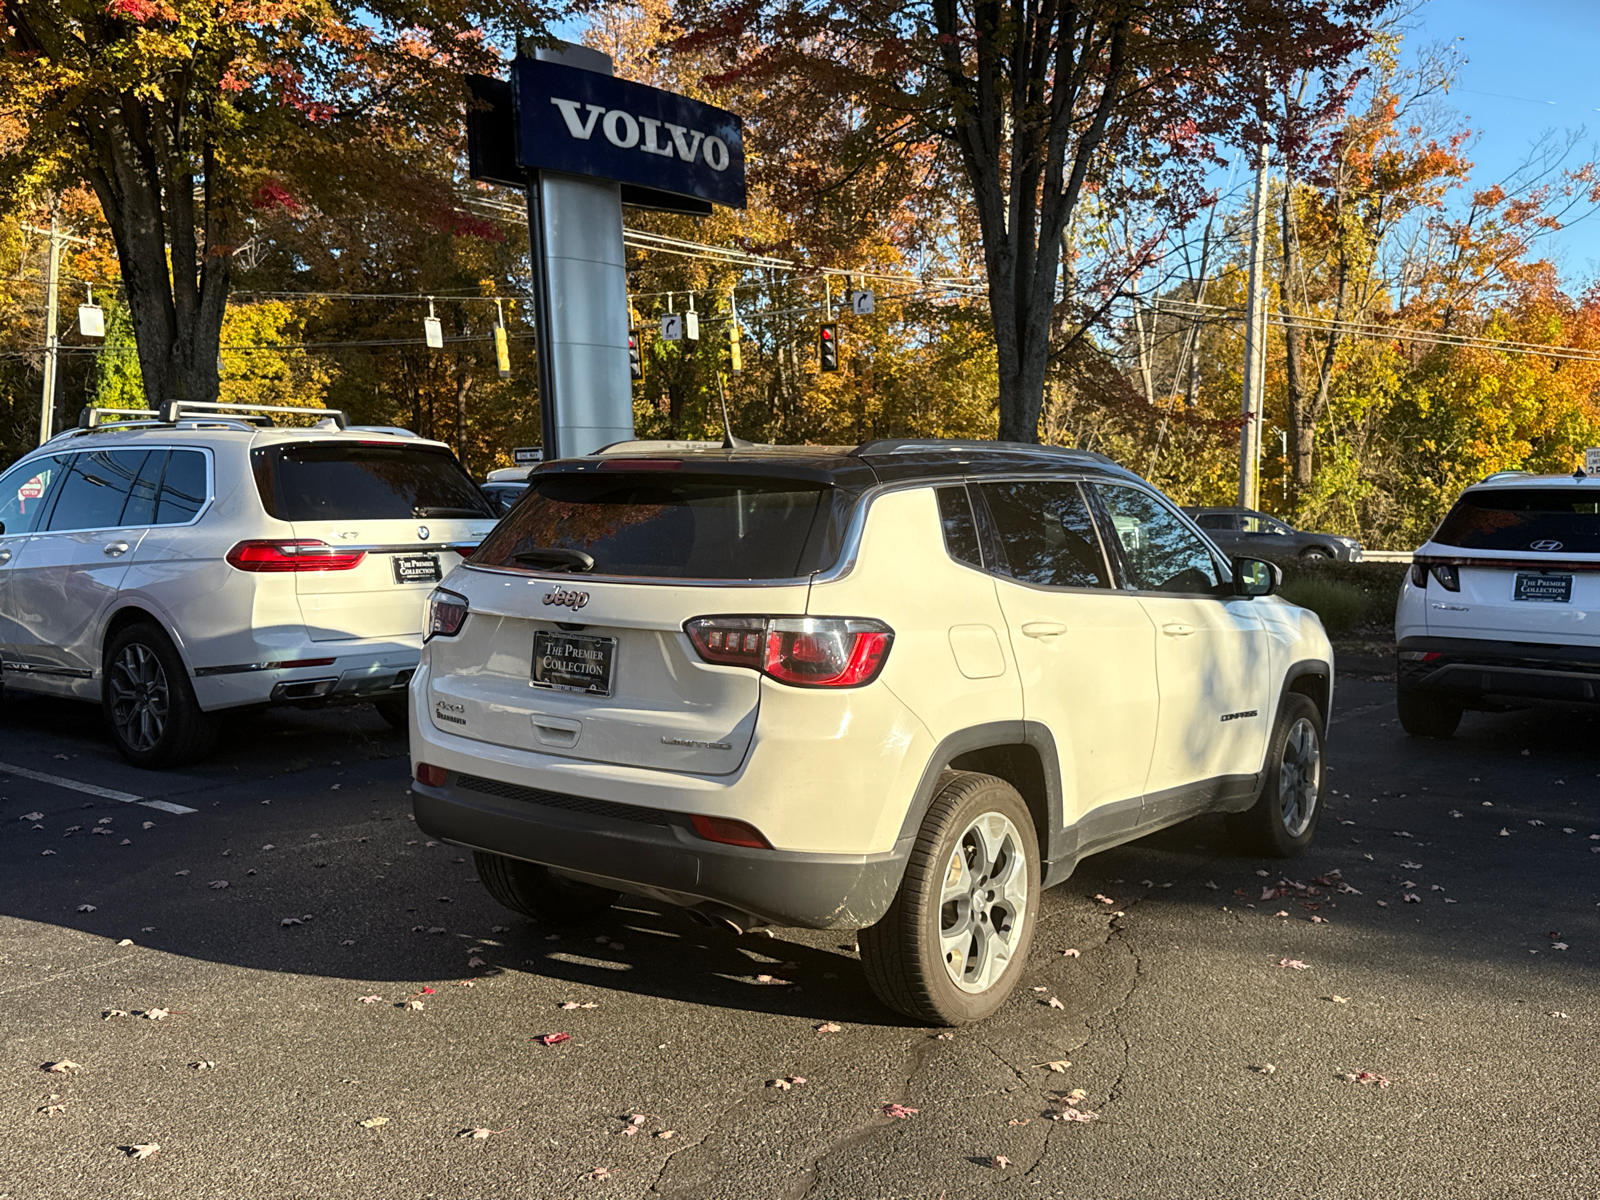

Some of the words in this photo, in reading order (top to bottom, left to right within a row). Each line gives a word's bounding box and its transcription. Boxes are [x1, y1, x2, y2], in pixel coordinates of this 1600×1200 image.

[550, 97, 730, 172] VOLVO
[400, 567, 436, 575] COLLECTION
[542, 585, 590, 611] Jeep
[1520, 585, 1566, 594] COLLECTION
[545, 642, 563, 656] THE
[564, 644, 604, 660] PREMIER
[542, 655, 603, 675] COLLECTION
[660, 736, 733, 751] LIMITED
